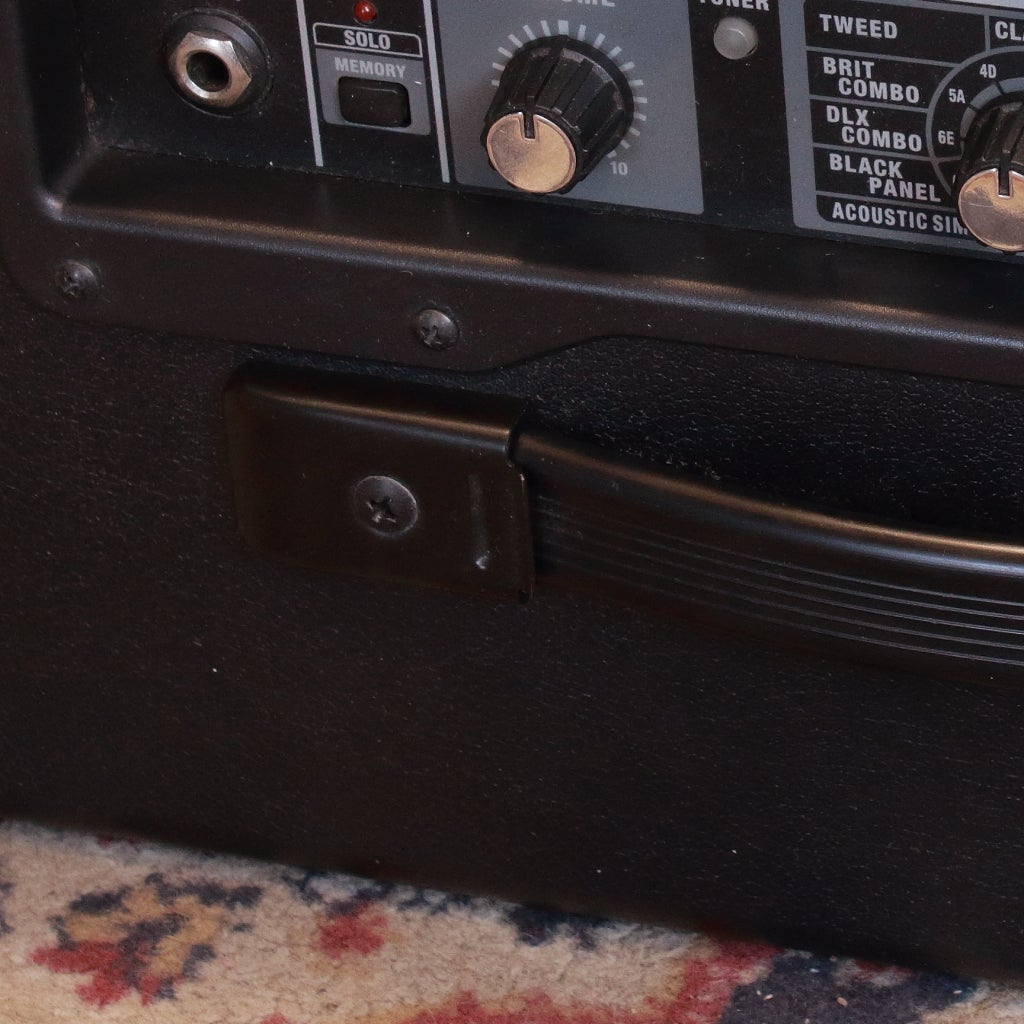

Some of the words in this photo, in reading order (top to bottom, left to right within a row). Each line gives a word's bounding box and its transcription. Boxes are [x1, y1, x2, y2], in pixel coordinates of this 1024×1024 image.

[819, 14, 898, 39] TWEED
[344, 29, 391, 50] SOLO
[334, 56, 406, 78] MEMORY
[823, 57, 875, 79] BRIT
[980, 64, 997, 78] 4D
[838, 77, 920, 103] COMBO
[949, 89, 966, 103] 5A
[826, 105, 870, 127] DLX
[841, 126, 922, 152] COMBO
[938, 130, 955, 145] 6E
[609, 160, 628, 175] 10
[829, 154, 903, 179] BLACK
[869, 177, 941, 202] PANEL
[833, 202, 928, 229] ACOUSTIC
